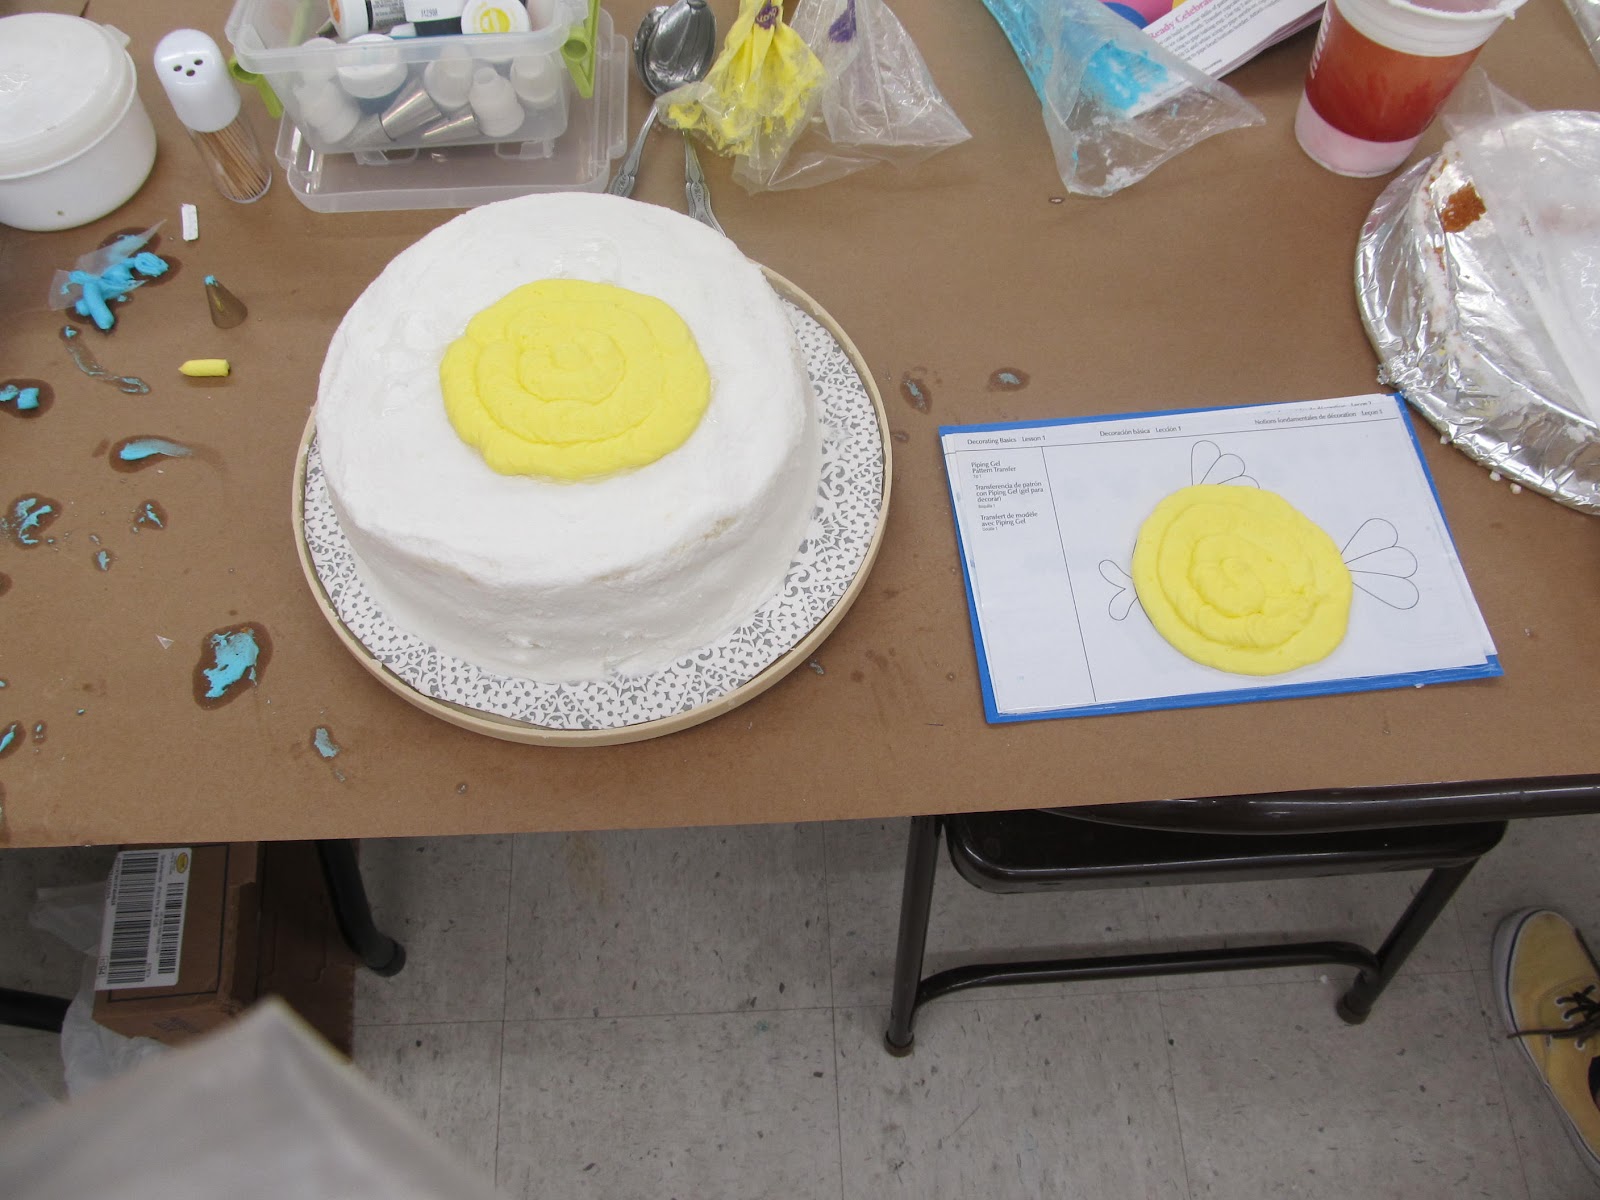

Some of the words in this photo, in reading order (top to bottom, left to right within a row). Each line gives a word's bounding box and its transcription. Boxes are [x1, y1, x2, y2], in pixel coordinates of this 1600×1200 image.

[1277, 414, 1317, 423] fondamentales
[1100, 428, 1132, 437] Decoración
[975, 482, 1012, 490] Transferencia
